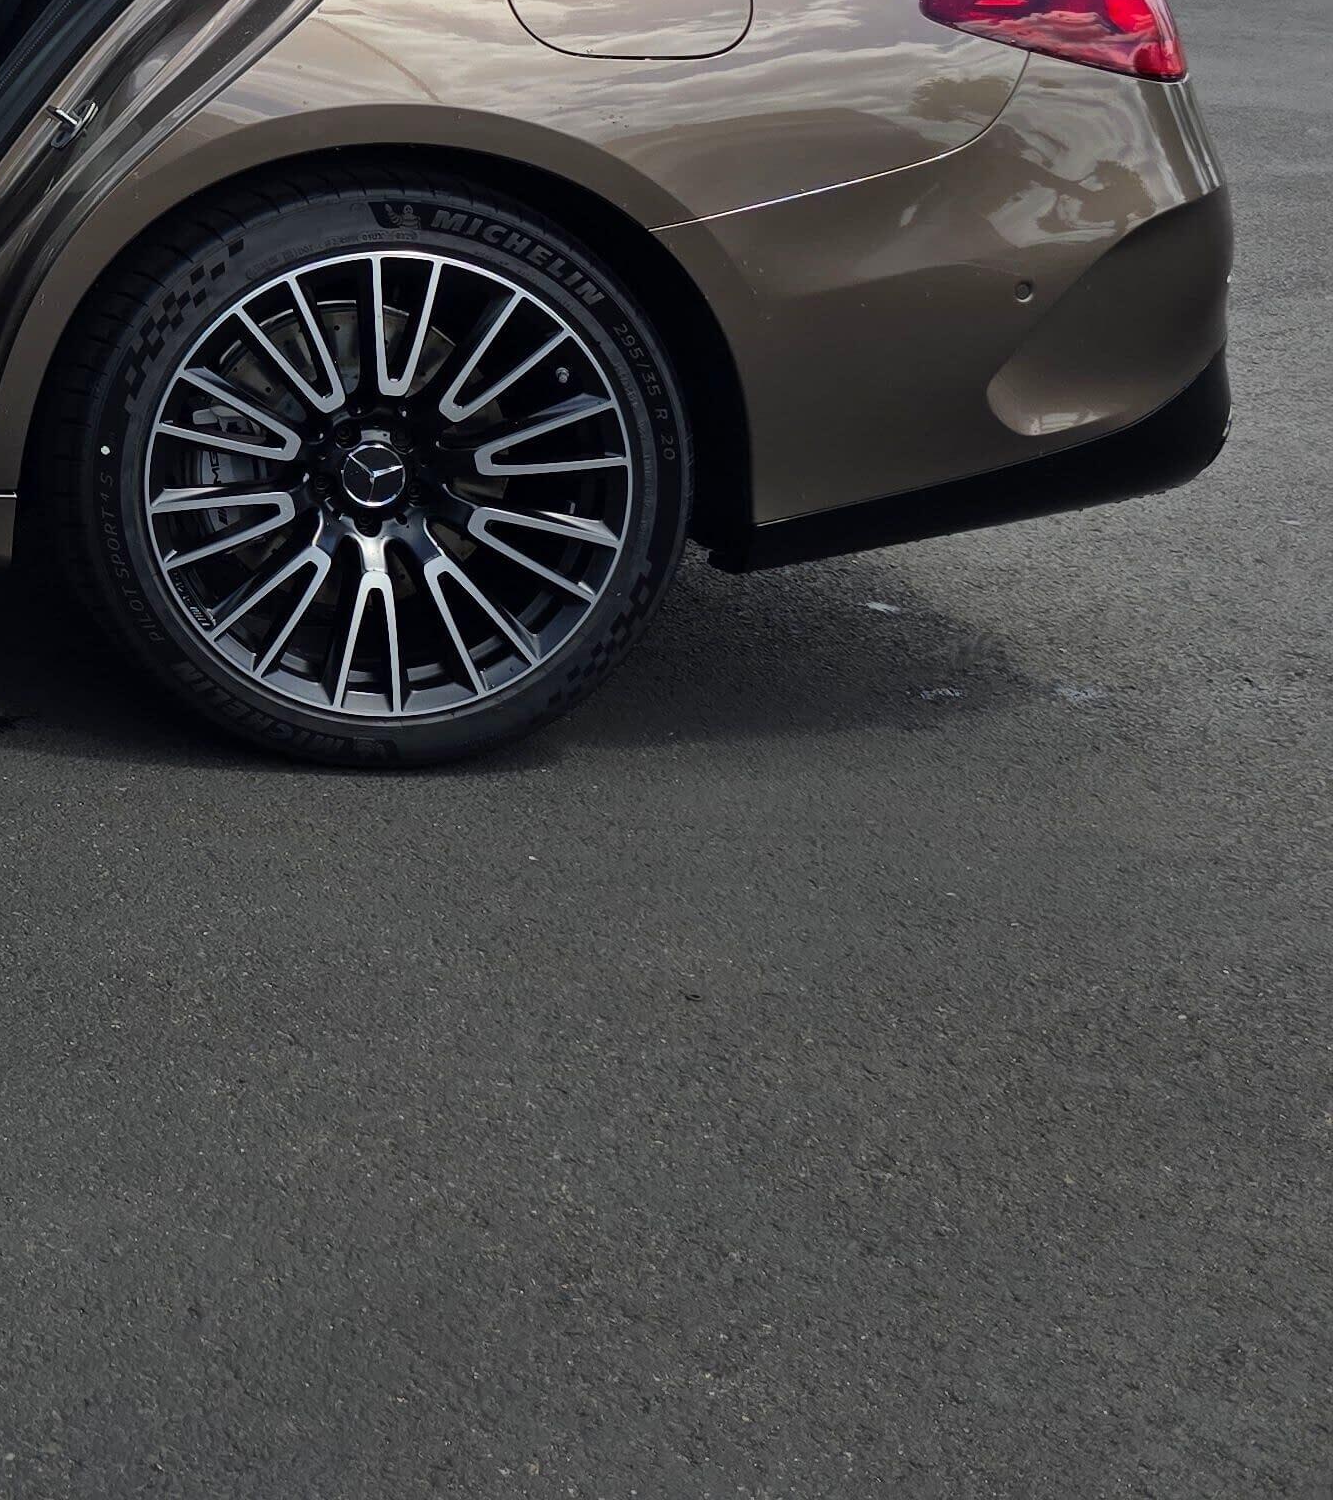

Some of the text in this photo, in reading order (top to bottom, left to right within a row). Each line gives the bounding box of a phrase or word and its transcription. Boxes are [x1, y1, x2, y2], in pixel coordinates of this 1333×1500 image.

[431, 209, 605, 306] MICHELIN
[613, 323, 663, 396] 295/35
[654, 404, 669, 420] R
[661, 433, 676, 461] 20
[101, 471, 114, 487] S
[101, 509, 131, 580] SPORT
[122, 586, 165, 644] PILOT
